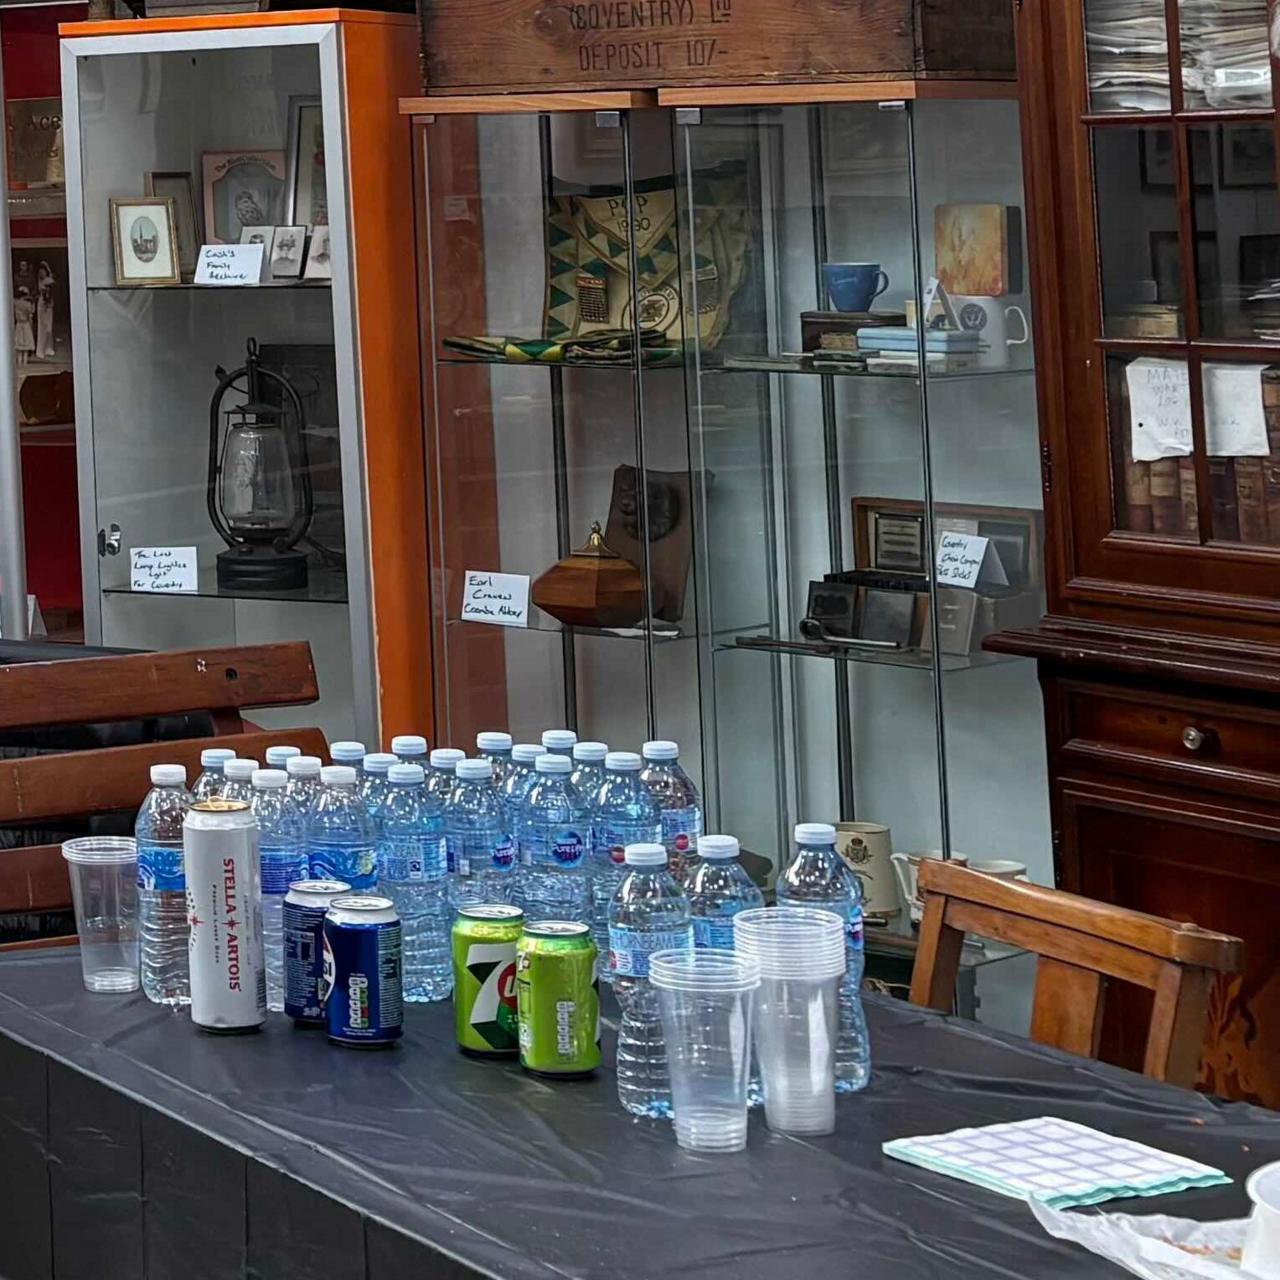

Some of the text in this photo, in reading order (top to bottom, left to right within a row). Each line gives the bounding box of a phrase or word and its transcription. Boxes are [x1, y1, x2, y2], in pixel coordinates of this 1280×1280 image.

[579, 39, 729, 72] DEPOSIT 10/-
[468, 575, 493, 587] Earl
[223, 858, 242, 993] STELLA ARTOIS
